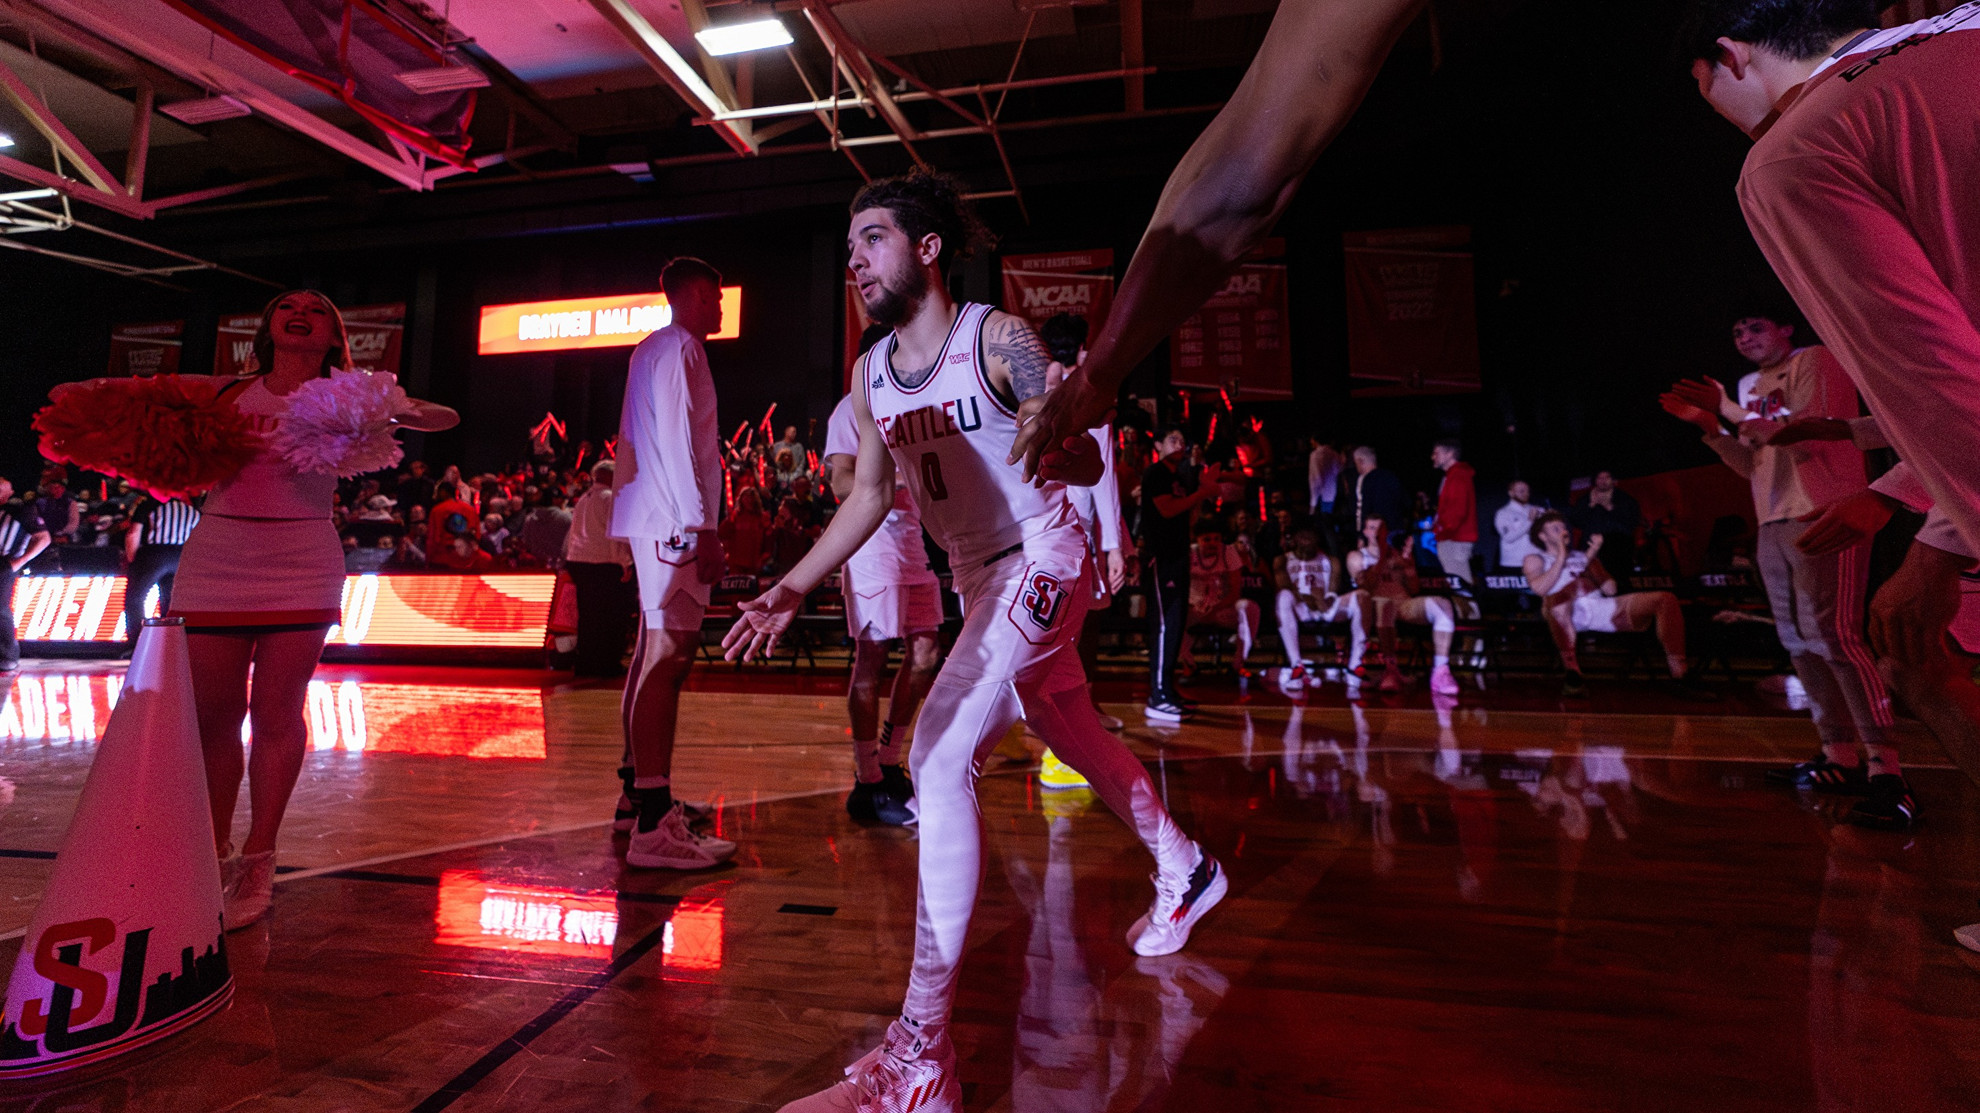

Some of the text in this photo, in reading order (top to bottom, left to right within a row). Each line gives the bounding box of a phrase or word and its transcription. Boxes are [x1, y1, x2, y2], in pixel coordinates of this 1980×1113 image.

[1022, 284, 1091, 308] NCAA
[519, 311, 592, 340] BRAYDEN
[349, 331, 391, 351] CAA
[876, 396, 982, 449] EATTLEU
[921, 452, 948, 501] 0
[721, 579, 751, 590] SEATTLE
[1485, 576, 1529, 589] SEATTLE
